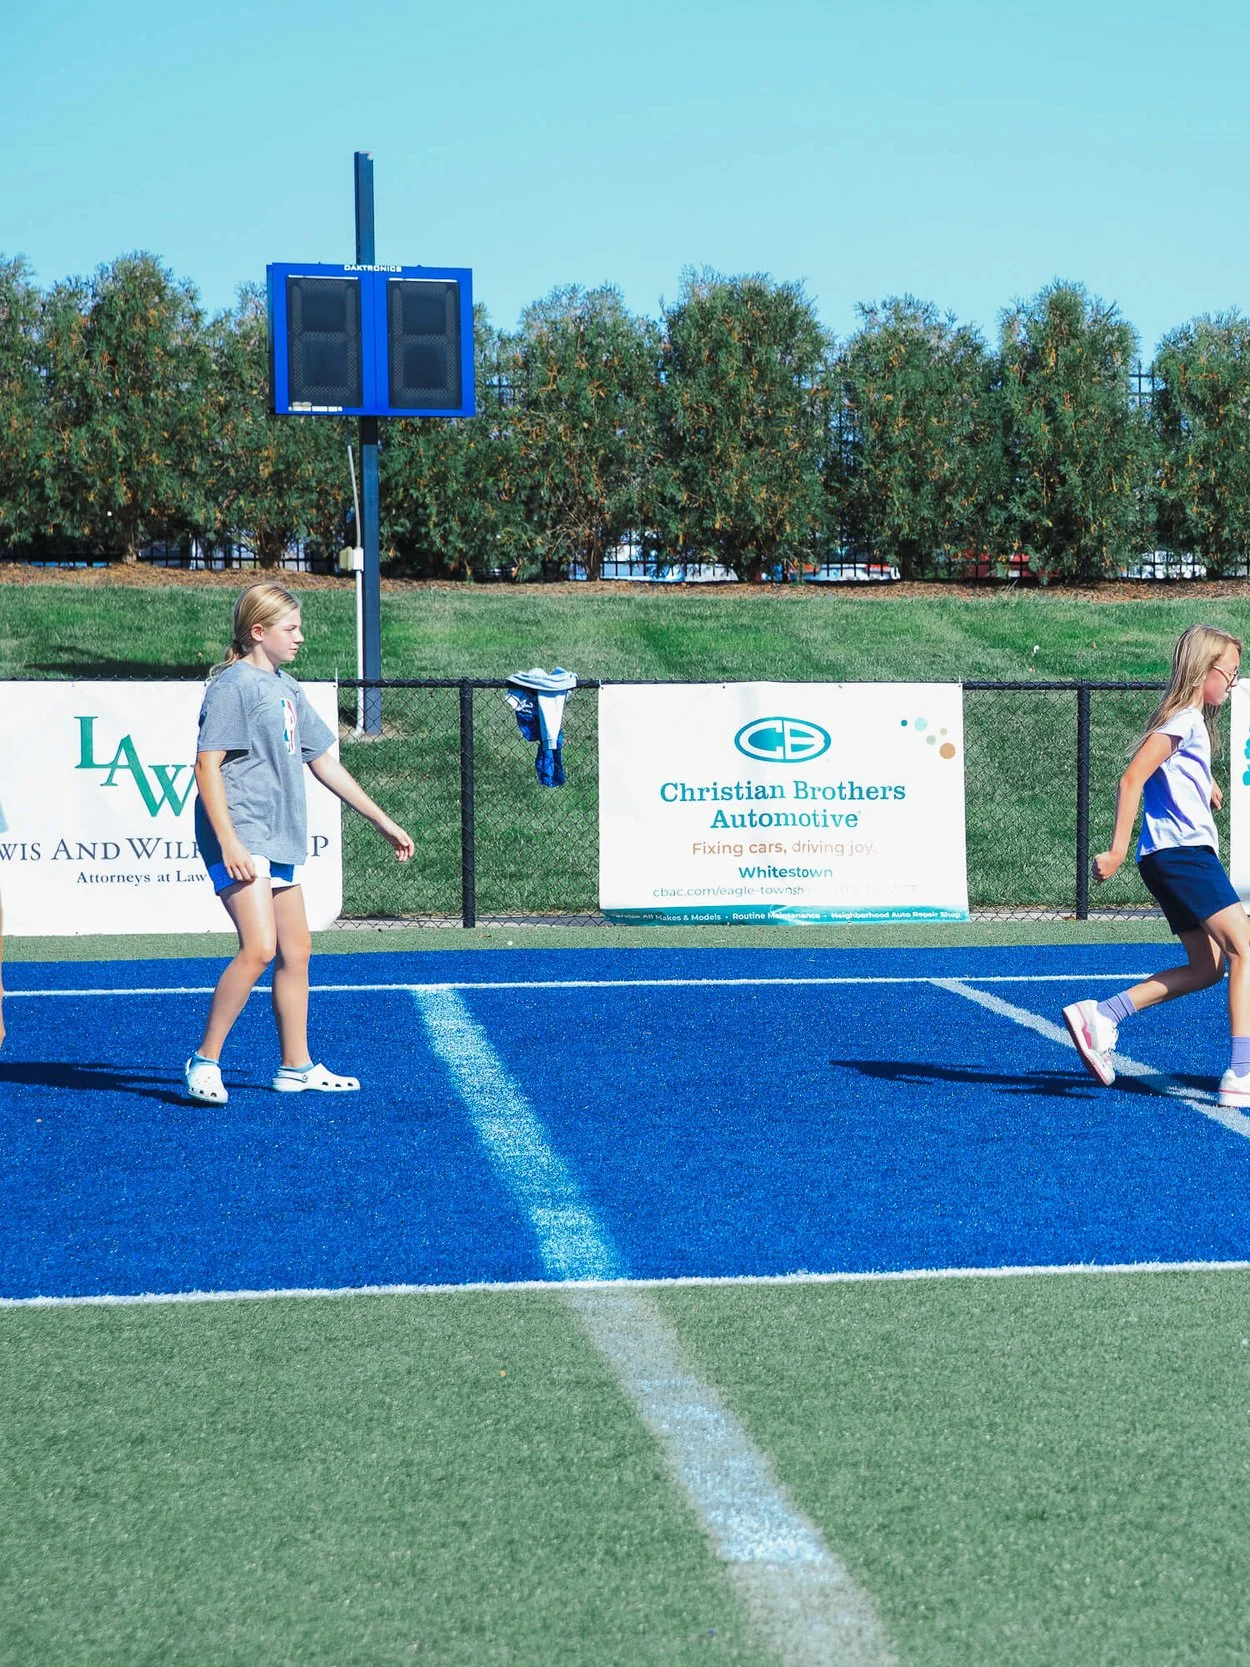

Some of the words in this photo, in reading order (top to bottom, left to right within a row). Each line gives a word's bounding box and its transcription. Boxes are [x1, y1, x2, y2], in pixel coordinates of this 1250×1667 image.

[660, 781, 785, 802] Christian
[793, 780, 906, 800] Brothers
[710, 809, 858, 828] Automotive
[51, 838, 121, 860] AND
[692, 841, 743, 857] Fixing
[750, 842, 787, 854] cars,
[792, 840, 844, 856] driving
[77, 871, 150, 886] Attorneys
[157, 873, 170, 883] at
[176, 870, 208, 882] Law
[739, 865, 833, 879] Whitestown
[691, 913, 722, 921] Models
[732, 911, 766, 920] Routine
[891, 911, 911, 919] Auto
[940, 911, 961, 920] Shop
